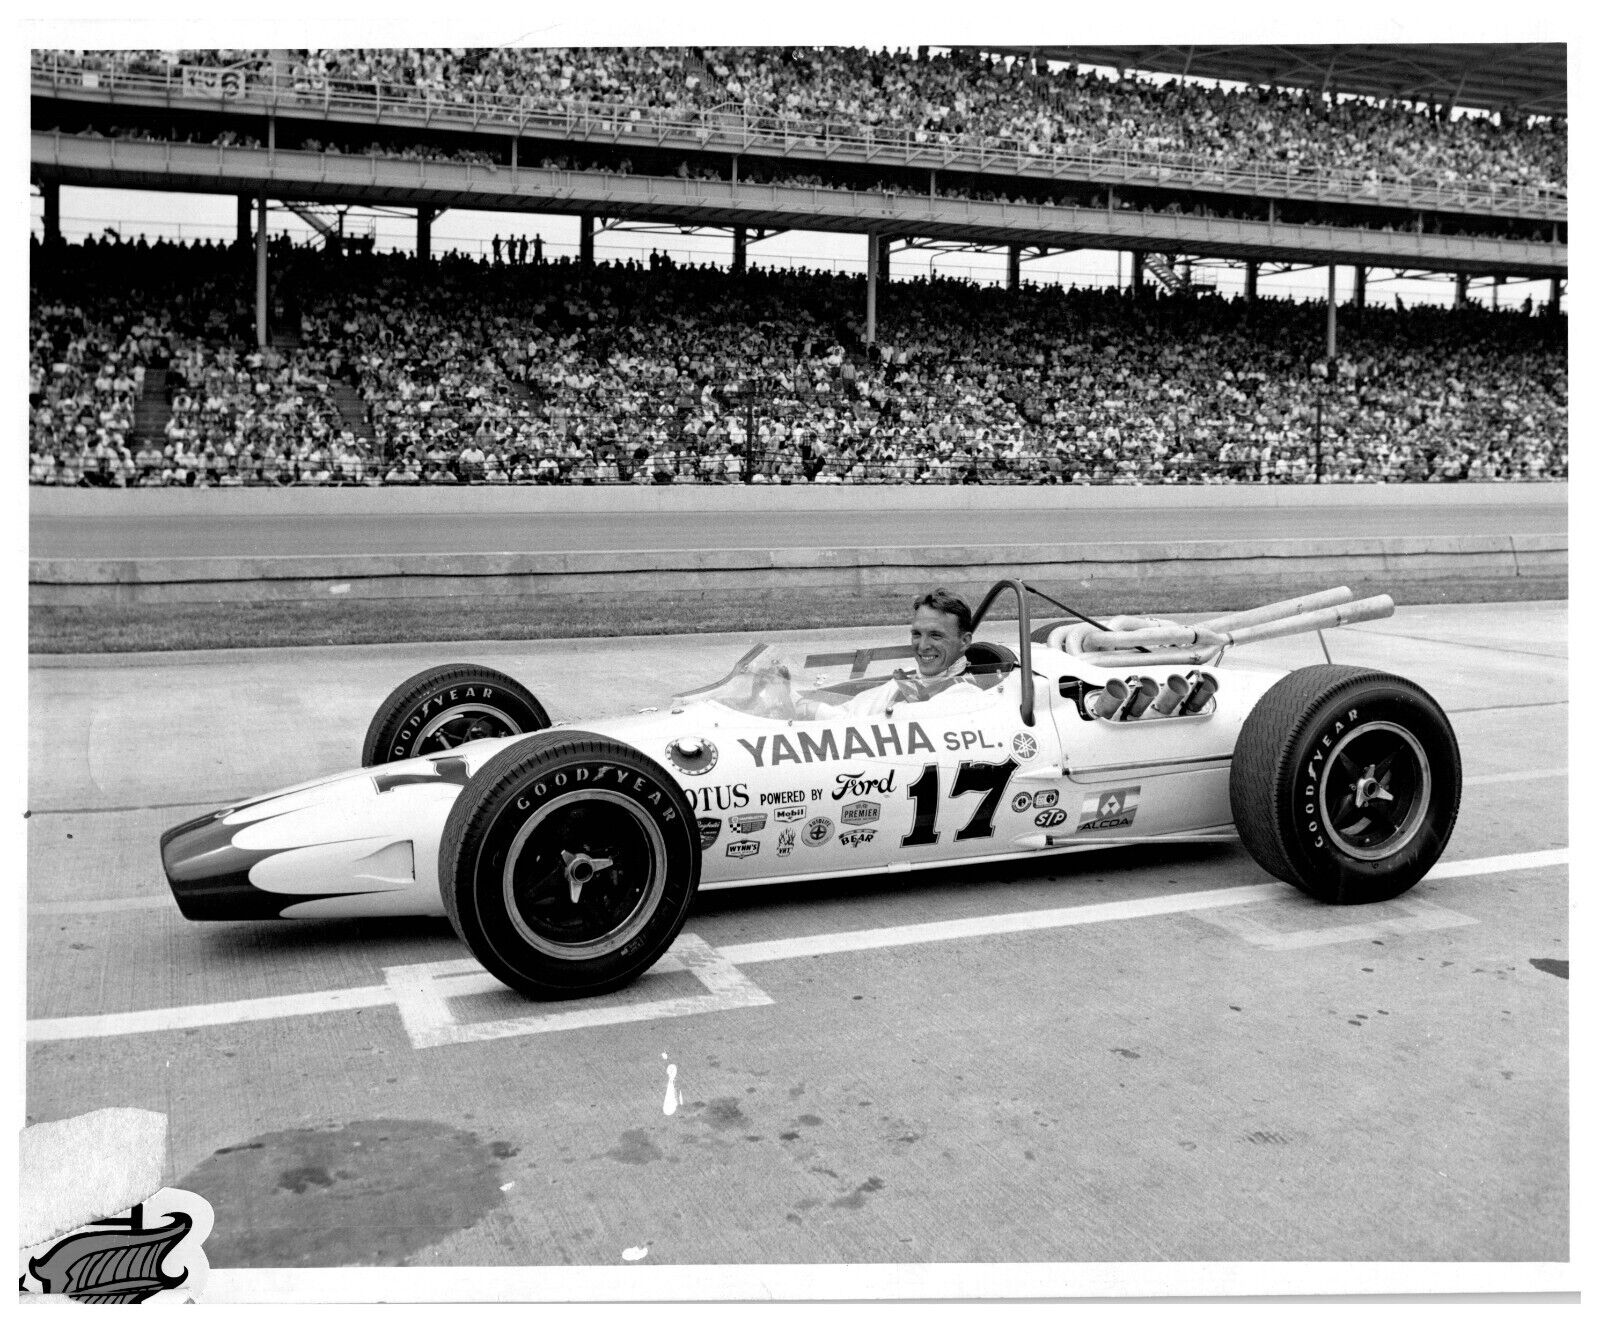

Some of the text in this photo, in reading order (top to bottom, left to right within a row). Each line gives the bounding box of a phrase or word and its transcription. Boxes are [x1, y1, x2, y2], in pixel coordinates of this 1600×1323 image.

[394, 687, 493, 756] OODYEAR
[737, 721, 1004, 767] YAMAHA SPL.
[683, 769, 898, 811] OTUS POWERED BY Ford
[1305, 708, 1358, 848] GOODYEAR
[516, 767, 677, 822] GOODYEAR
[900, 754, 1021, 849] 17
[777, 809, 804, 818] Mobil
[844, 808, 878, 818] PREMIER
[1036, 809, 1065, 826] STP
[1080, 818, 1129, 831] ALCOA
[729, 844, 757, 852] WYNN'S
[841, 833, 874, 846] BEAR
